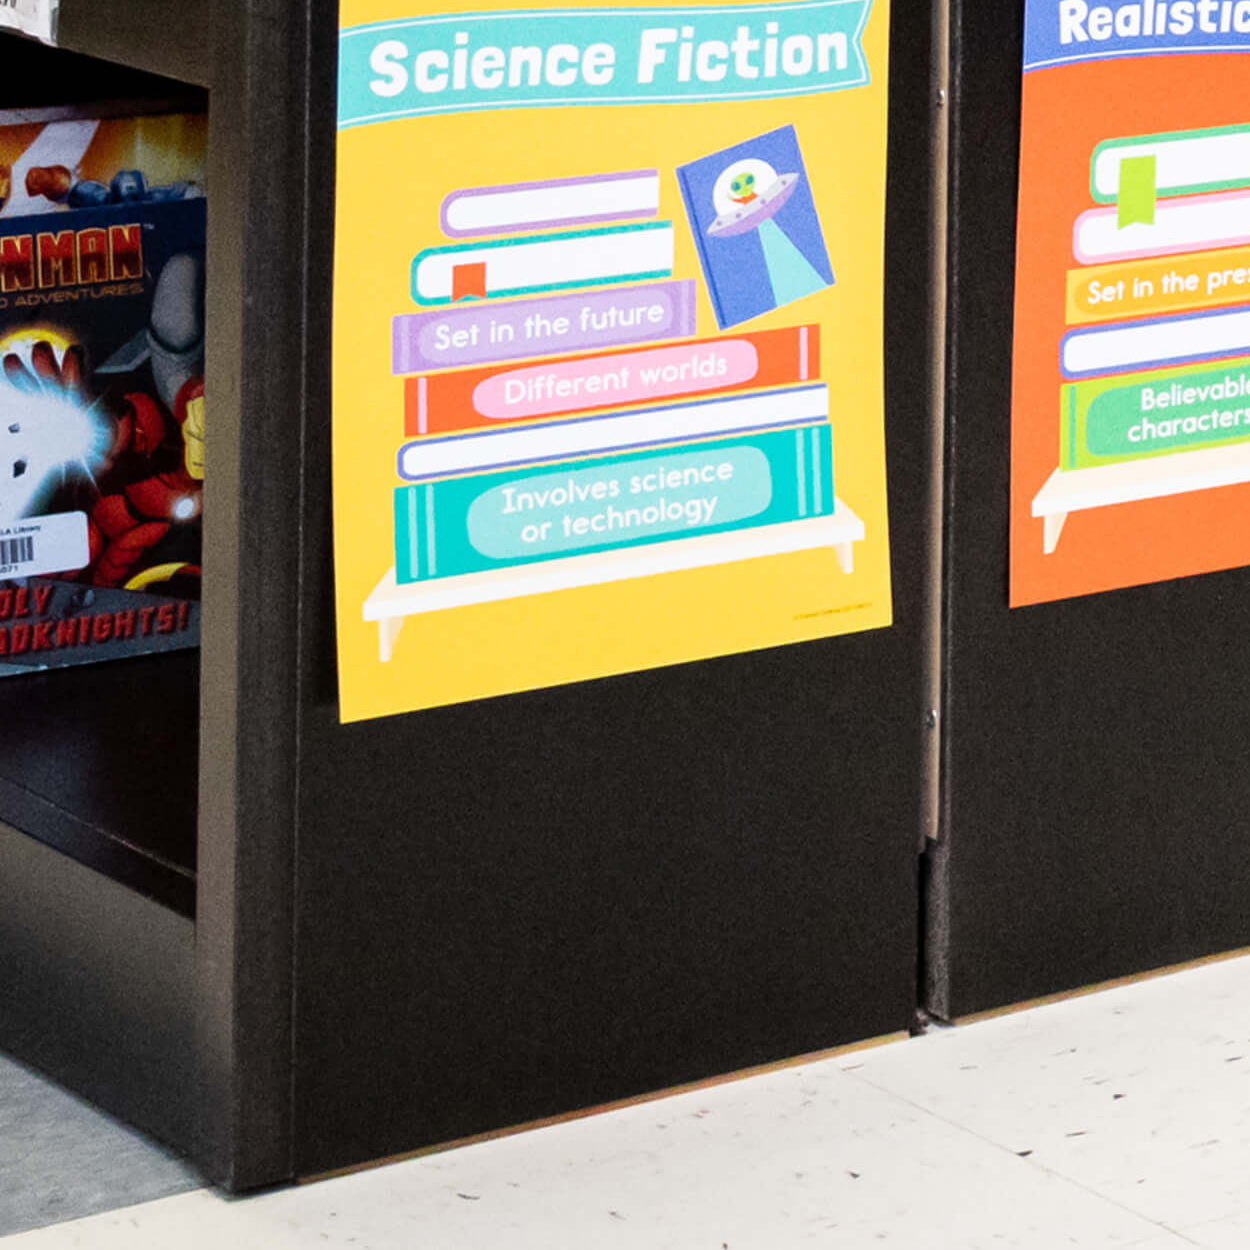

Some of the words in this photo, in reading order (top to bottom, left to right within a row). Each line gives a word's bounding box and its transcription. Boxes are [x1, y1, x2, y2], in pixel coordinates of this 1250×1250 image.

[369, 32, 616, 98] Science
[637, 22, 848, 85] Fiction
[15, 283, 144, 307] ADVENTURES
[1087, 281, 1125, 305] Set
[1133, 276, 1153, 299] in
[1162, 270, 1199, 295] the
[434, 323, 480, 350] Set
[489, 318, 514, 344] in
[524, 312, 569, 340] the
[579, 303, 665, 333] future
[504, 370, 630, 405] Different
[640, 354, 727, 386] worlds
[502, 478, 620, 514] Involves
[629, 461, 734, 494] science
[521, 521, 554, 543] or
[562, 495, 719, 537] technology
